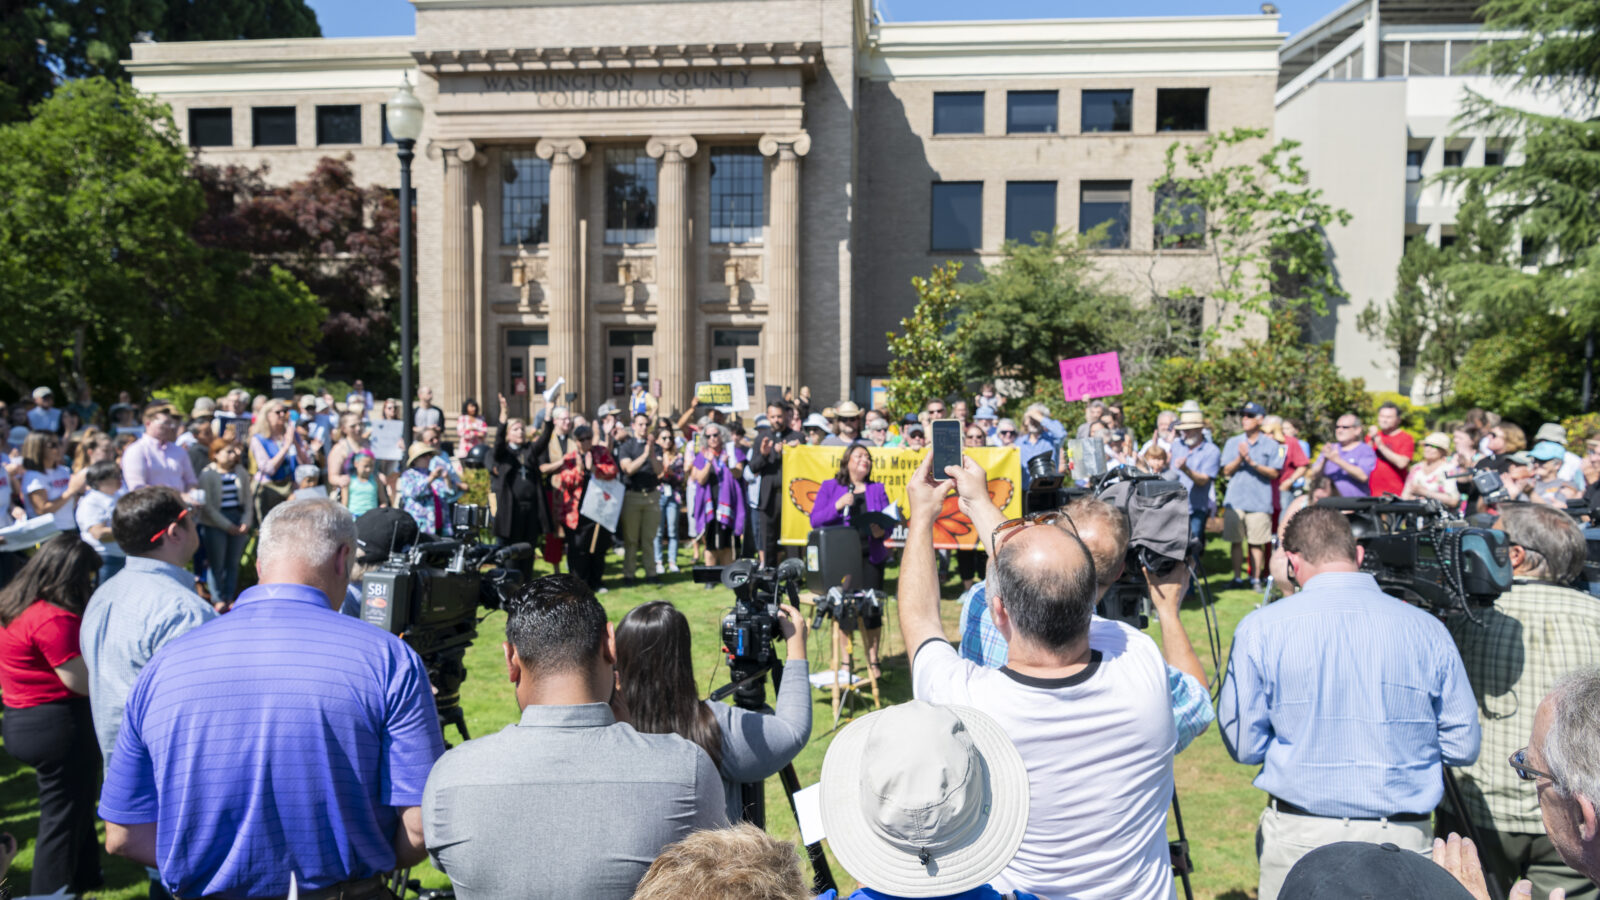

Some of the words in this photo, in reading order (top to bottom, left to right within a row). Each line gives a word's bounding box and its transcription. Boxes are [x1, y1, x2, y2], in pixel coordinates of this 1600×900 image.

[483, 71, 634, 91] WASHINGTON
[658, 69, 752, 88] COUNTY
[536, 89, 697, 108] COURTHOUSE
[1075, 360, 1105, 377] CLOSE
